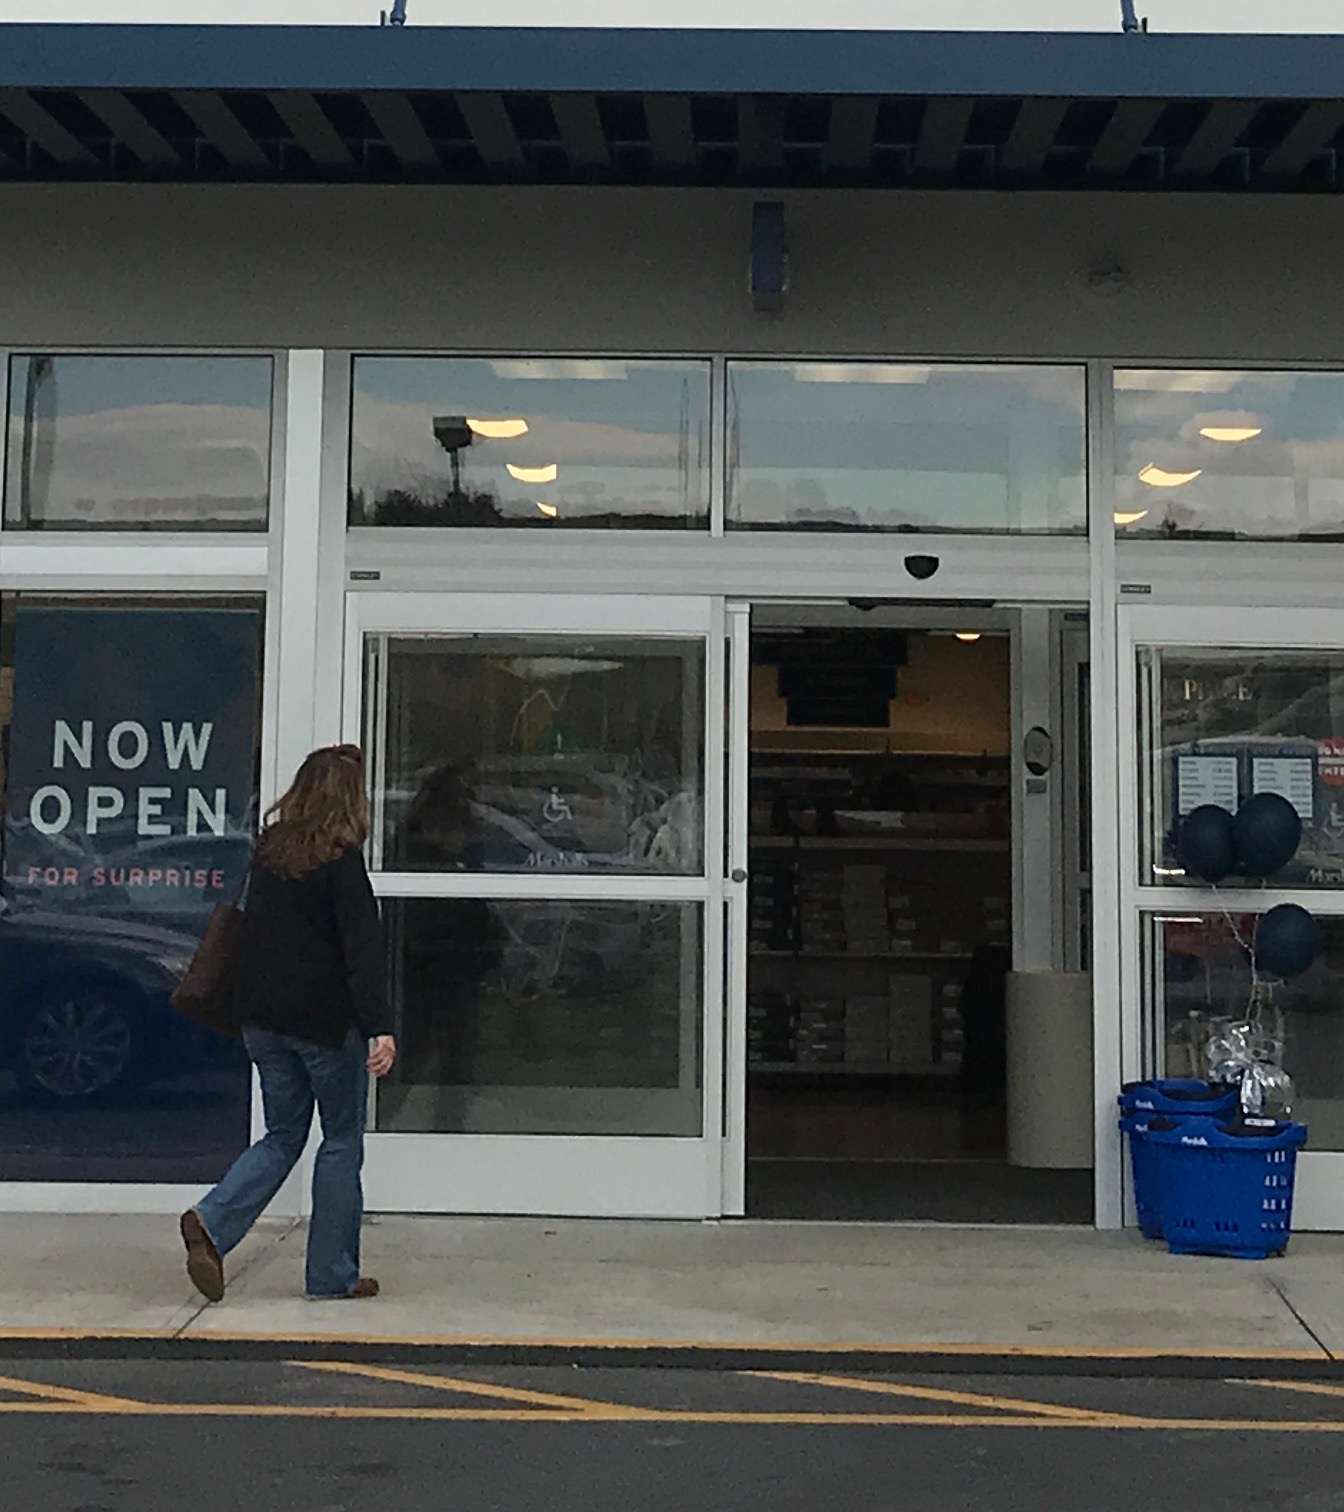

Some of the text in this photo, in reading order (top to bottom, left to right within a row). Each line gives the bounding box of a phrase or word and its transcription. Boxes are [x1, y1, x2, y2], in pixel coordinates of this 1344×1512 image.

[52, 719, 214, 772] NOW
[29, 784, 227, 838] OPEN
[27, 866, 226, 888] FOR SURPRISE
